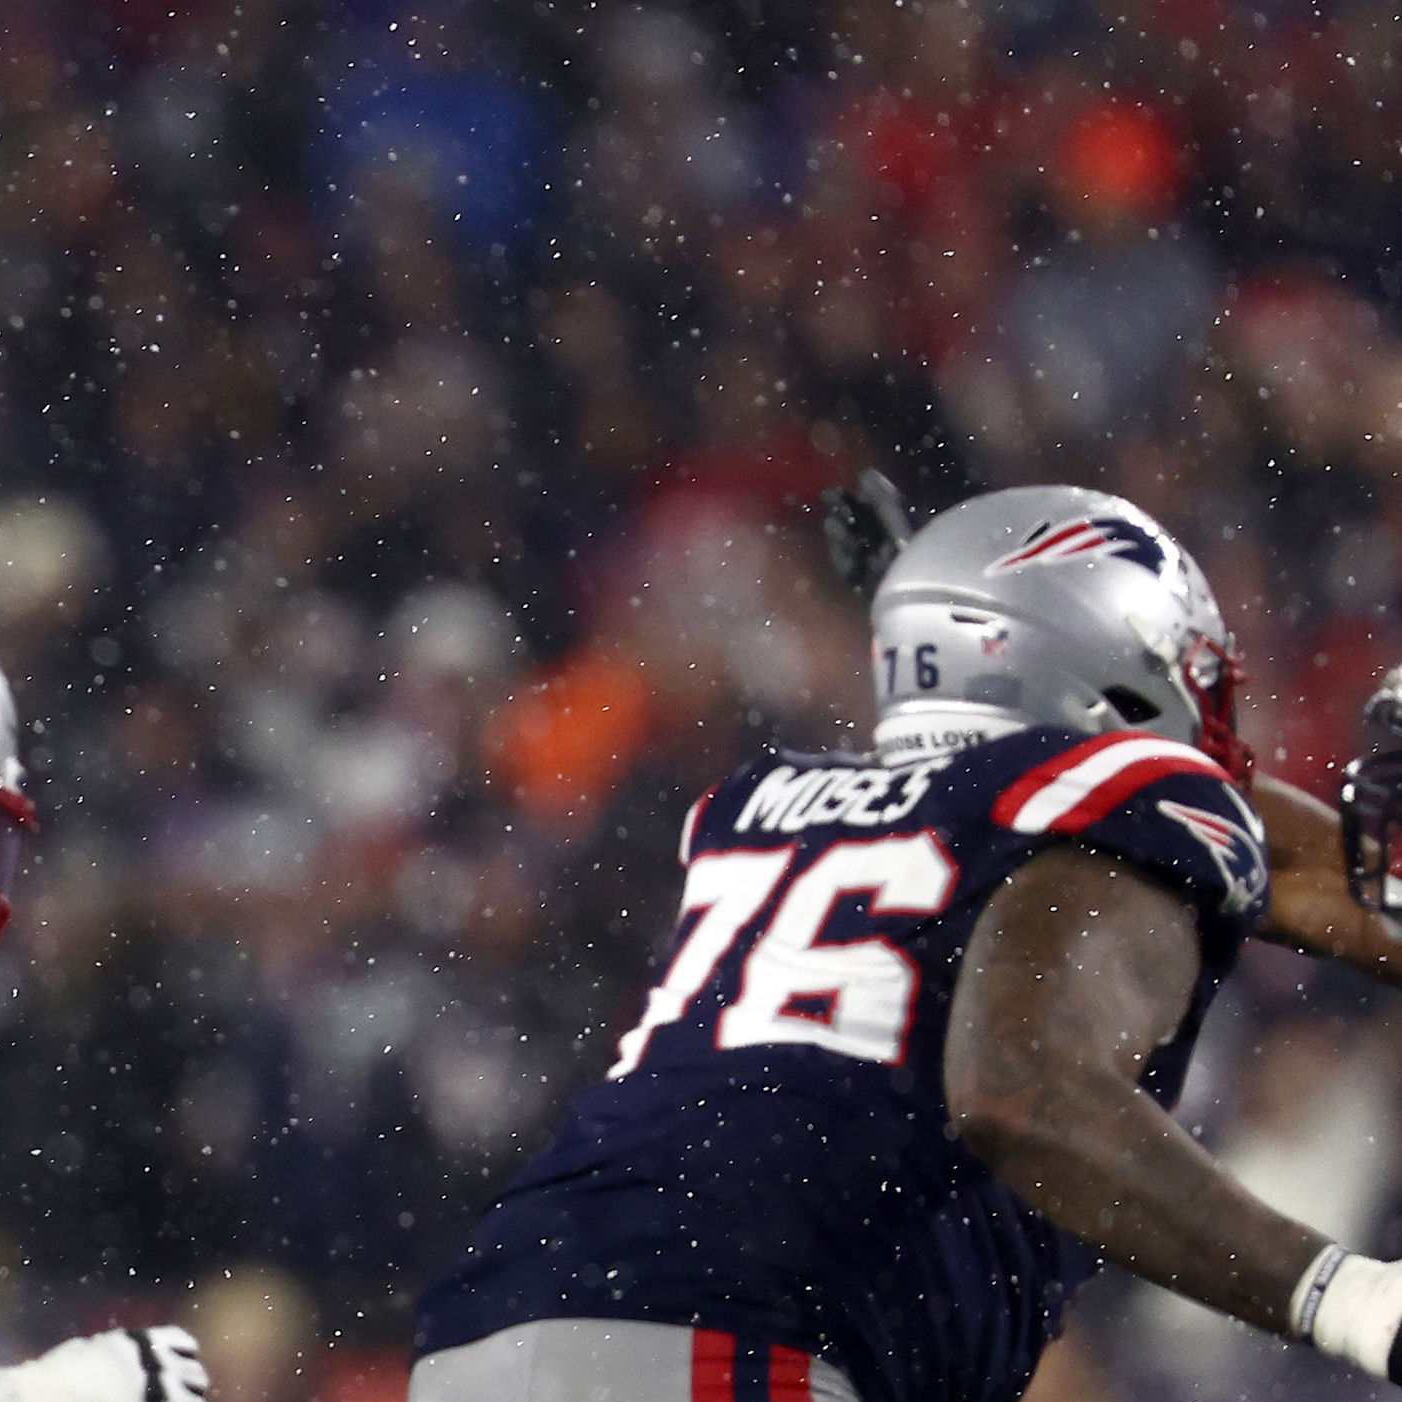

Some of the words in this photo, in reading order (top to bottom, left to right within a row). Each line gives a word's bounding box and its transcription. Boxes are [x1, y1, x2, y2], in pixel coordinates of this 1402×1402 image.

[883, 644, 939, 695] 76
[733, 757, 953, 834] MOSES
[605, 827, 960, 1080] 76
